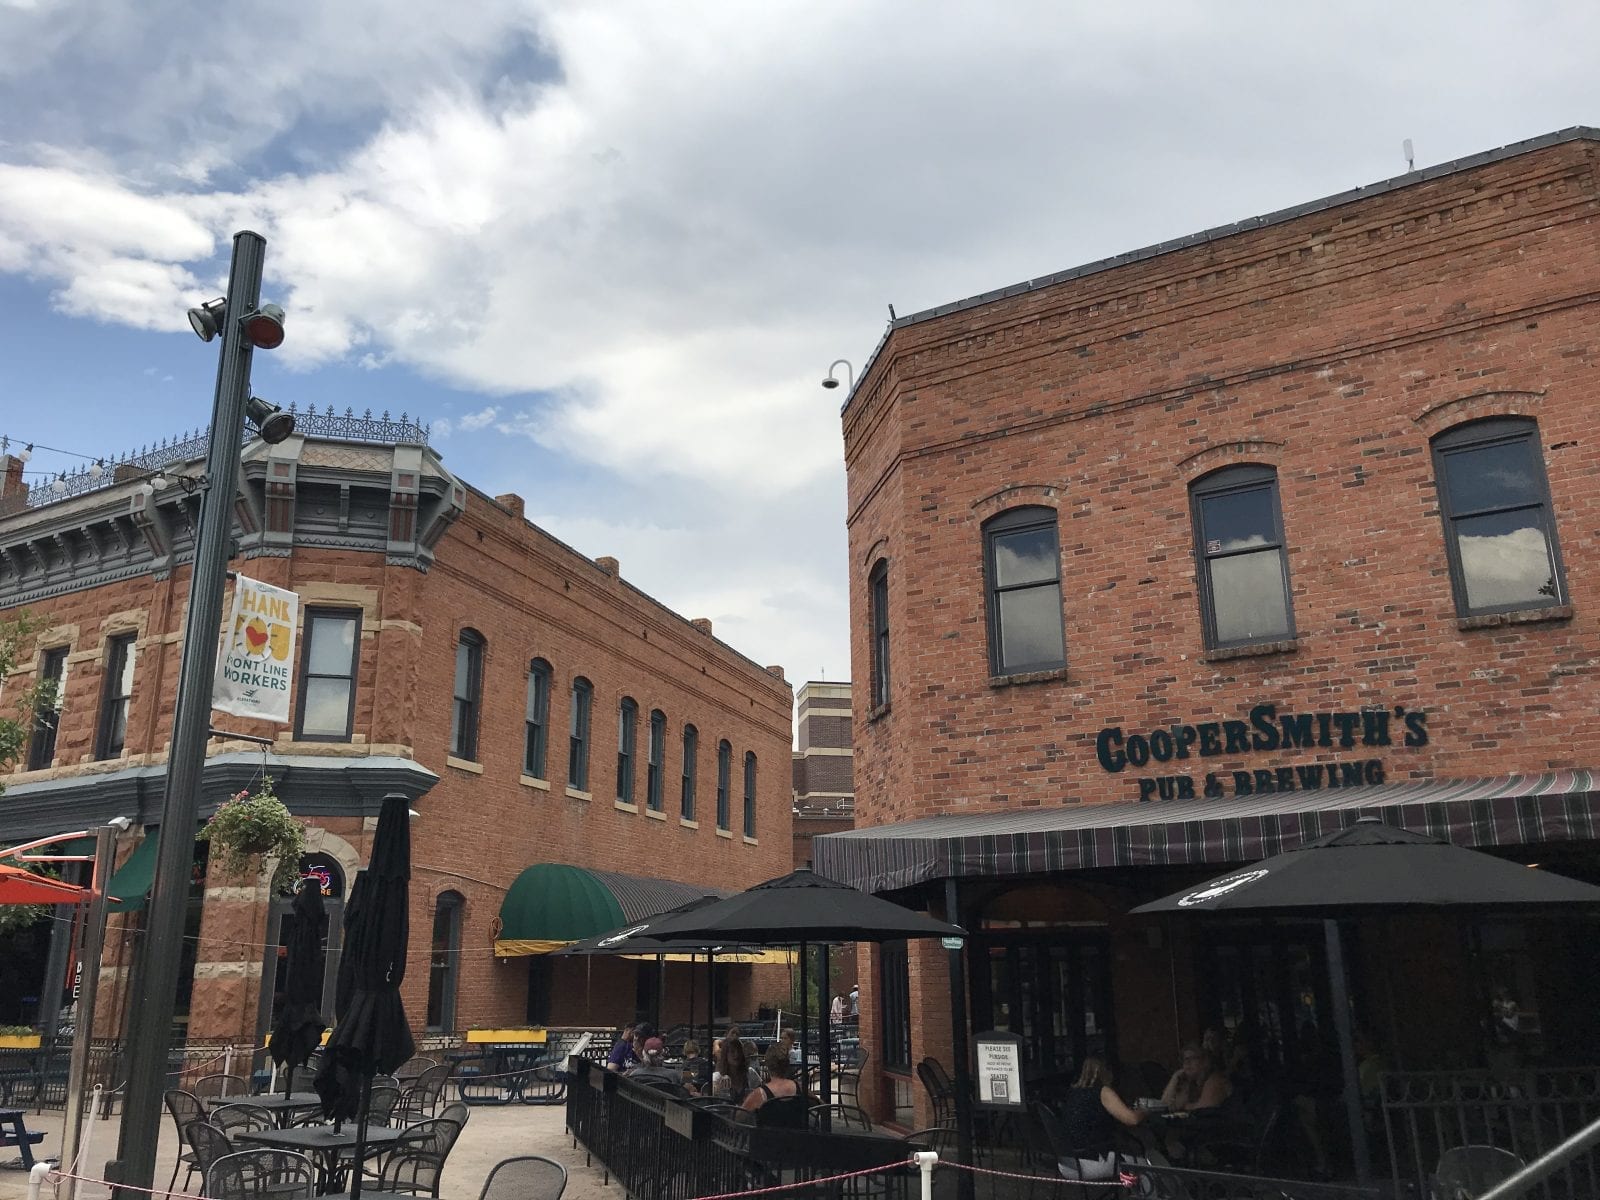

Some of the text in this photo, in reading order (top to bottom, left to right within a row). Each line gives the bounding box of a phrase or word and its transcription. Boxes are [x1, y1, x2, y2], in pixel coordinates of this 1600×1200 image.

[224, 666, 287, 691] WORKERS
[263, 663, 288, 678] LINE
[1138, 758, 1386, 802] PUB & BREWING
